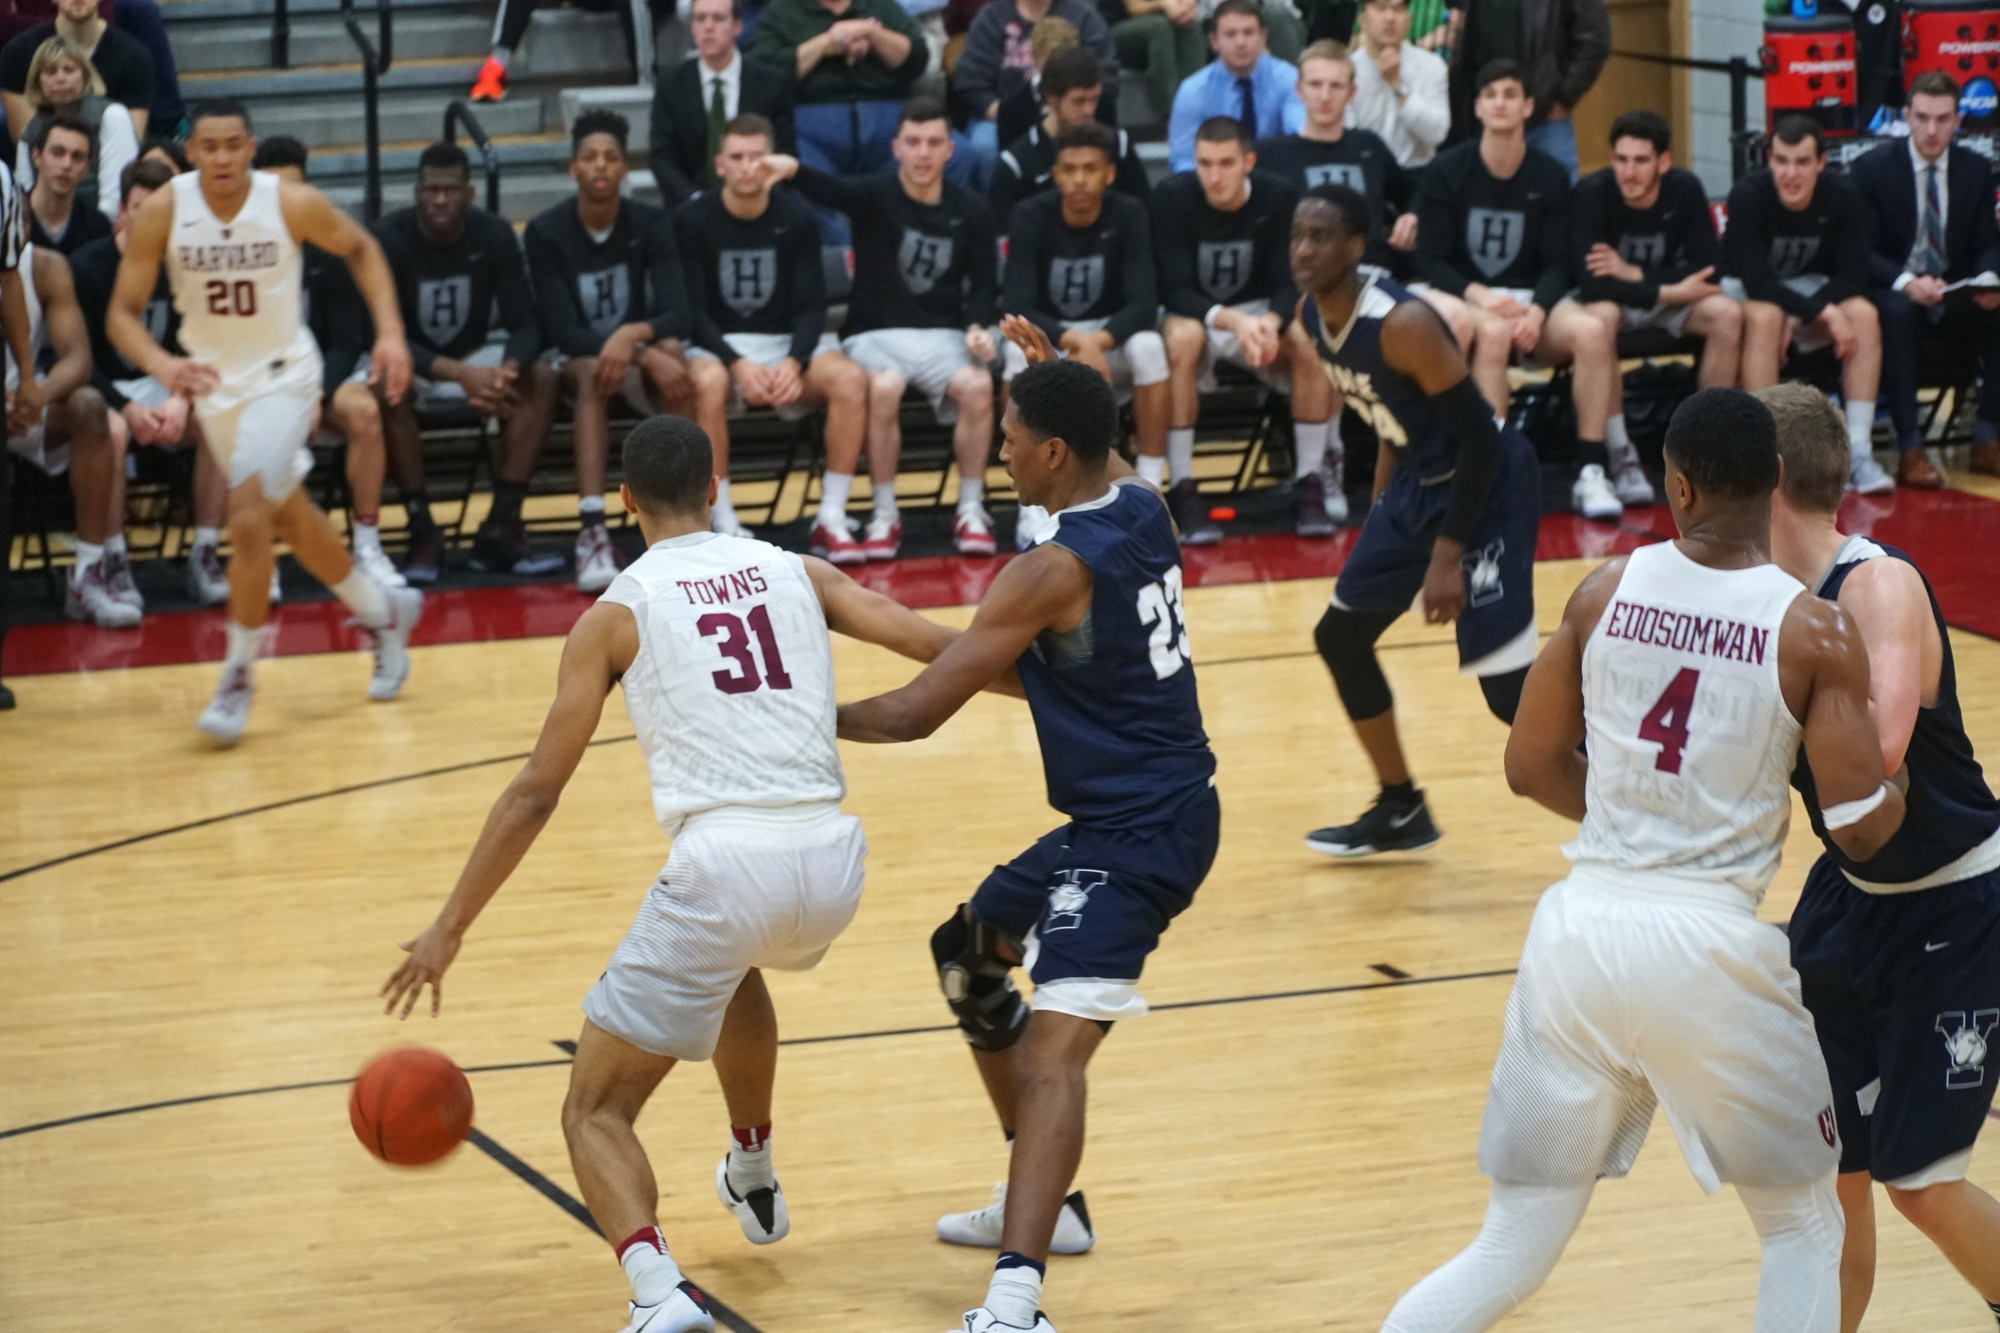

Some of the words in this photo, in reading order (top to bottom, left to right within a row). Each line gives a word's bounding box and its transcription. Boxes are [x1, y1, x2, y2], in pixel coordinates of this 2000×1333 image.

[178, 241, 277, 272] HARVARD
[1479, 216, 1511, 258] H
[732, 257, 762, 299] H
[907, 239, 939, 278] H
[1211, 249, 1240, 287] H
[205, 280, 257, 318] 20
[592, 273, 618, 320] H
[1062, 264, 1090, 303] H
[431, 284, 459, 328] H
[676, 565, 768, 605] TOWNS
[696, 603, 793, 695] 31
[1606, 601, 1769, 666] EDOSOMWAN
[1638, 666, 1700, 776] 4
